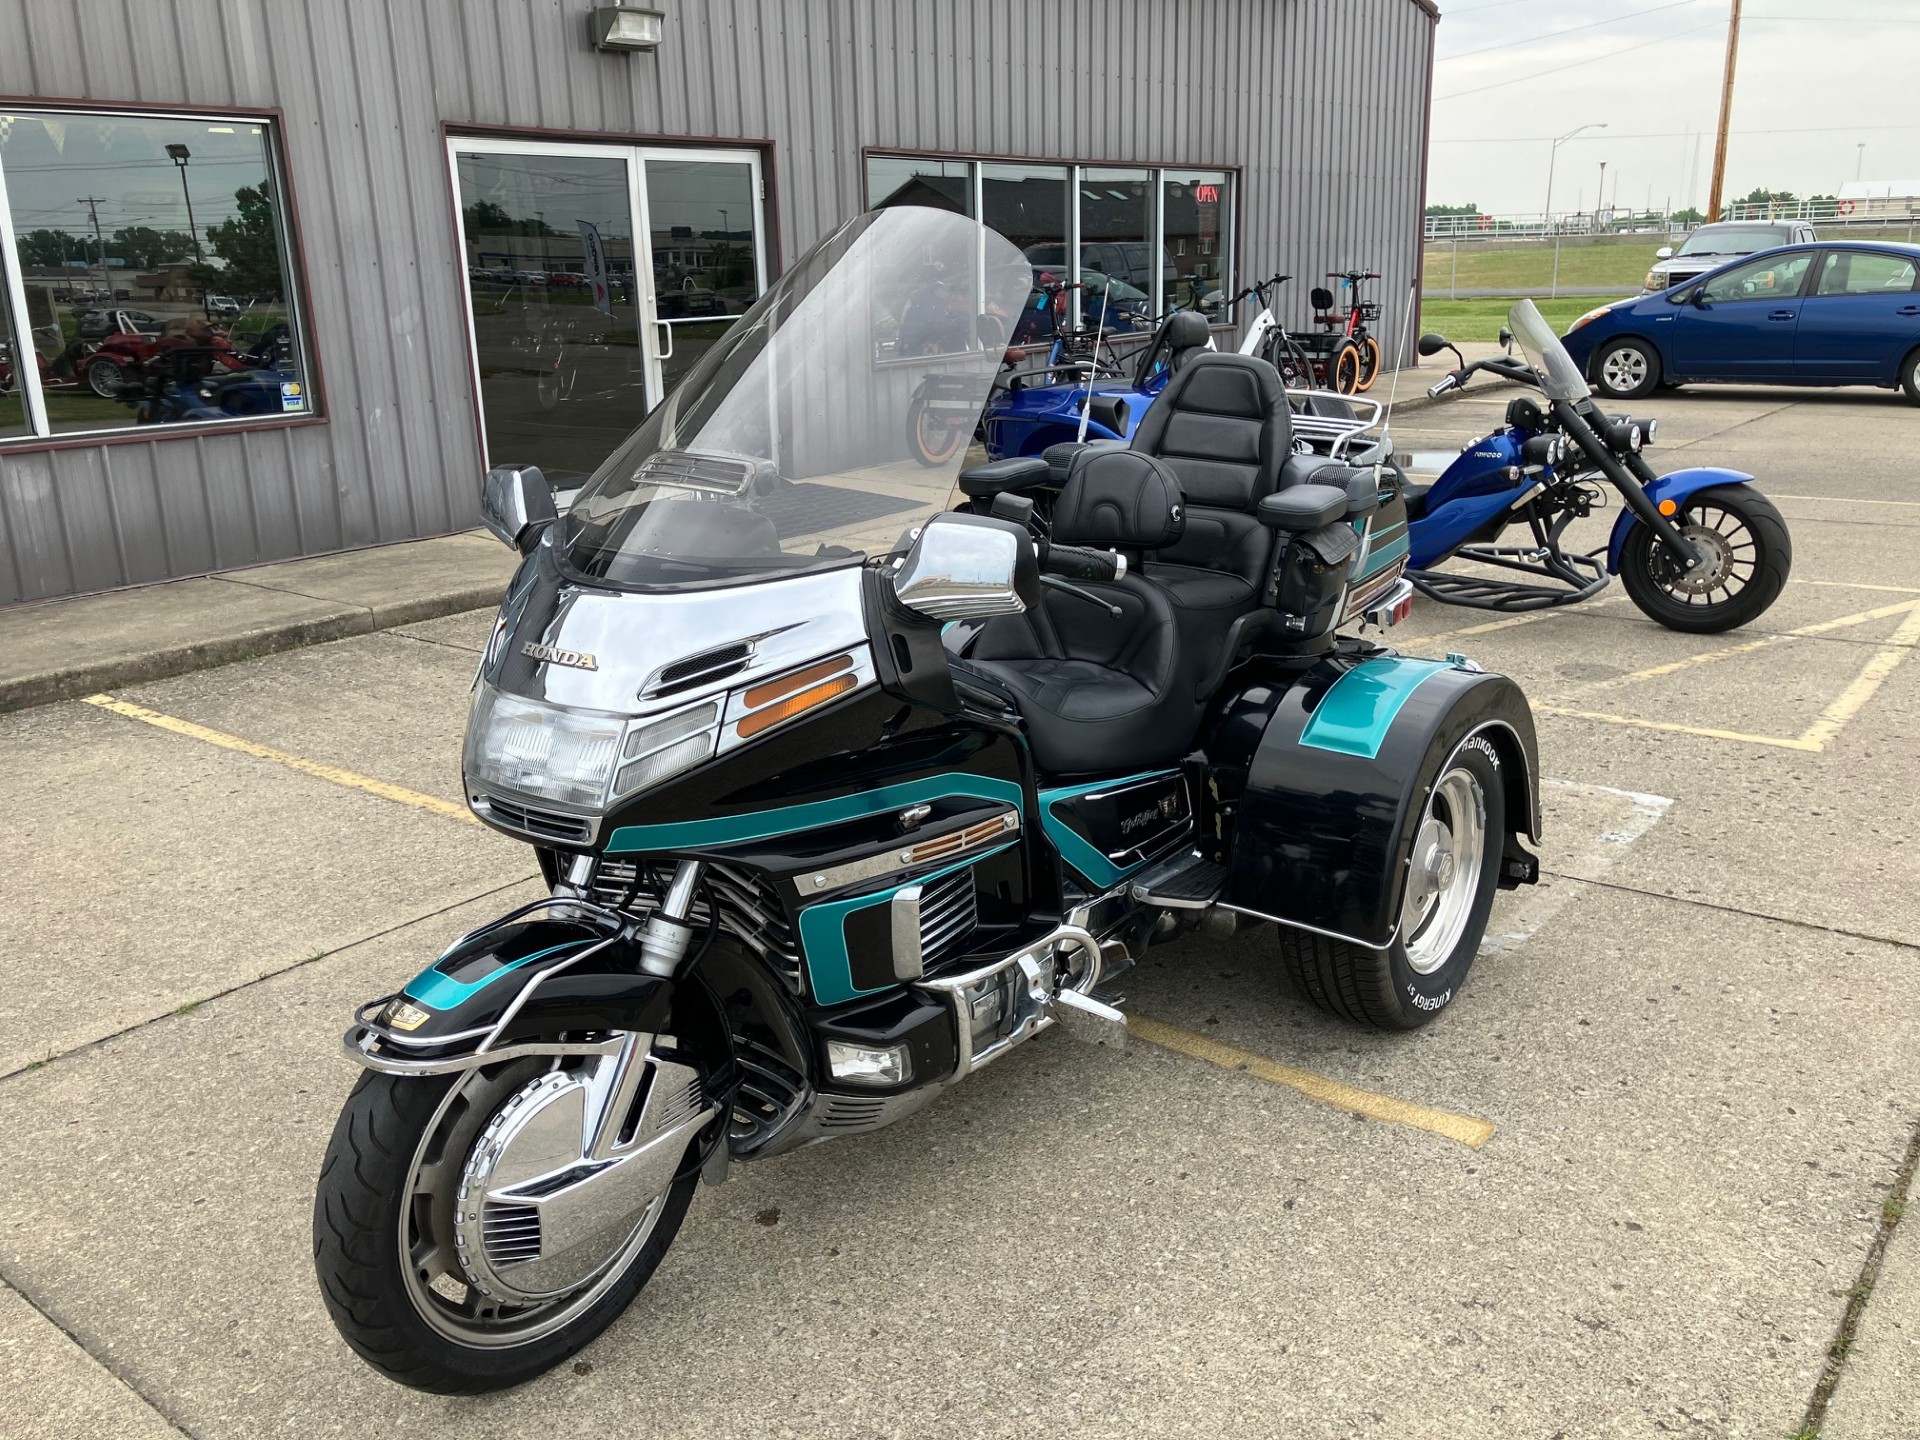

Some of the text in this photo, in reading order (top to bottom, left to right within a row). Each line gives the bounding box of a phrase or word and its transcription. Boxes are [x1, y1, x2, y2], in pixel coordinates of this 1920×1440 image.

[1196, 184, 1218, 203] OPEN
[520, 640, 599, 671] HONDA
[1411, 987, 1451, 1011] KINERGY
